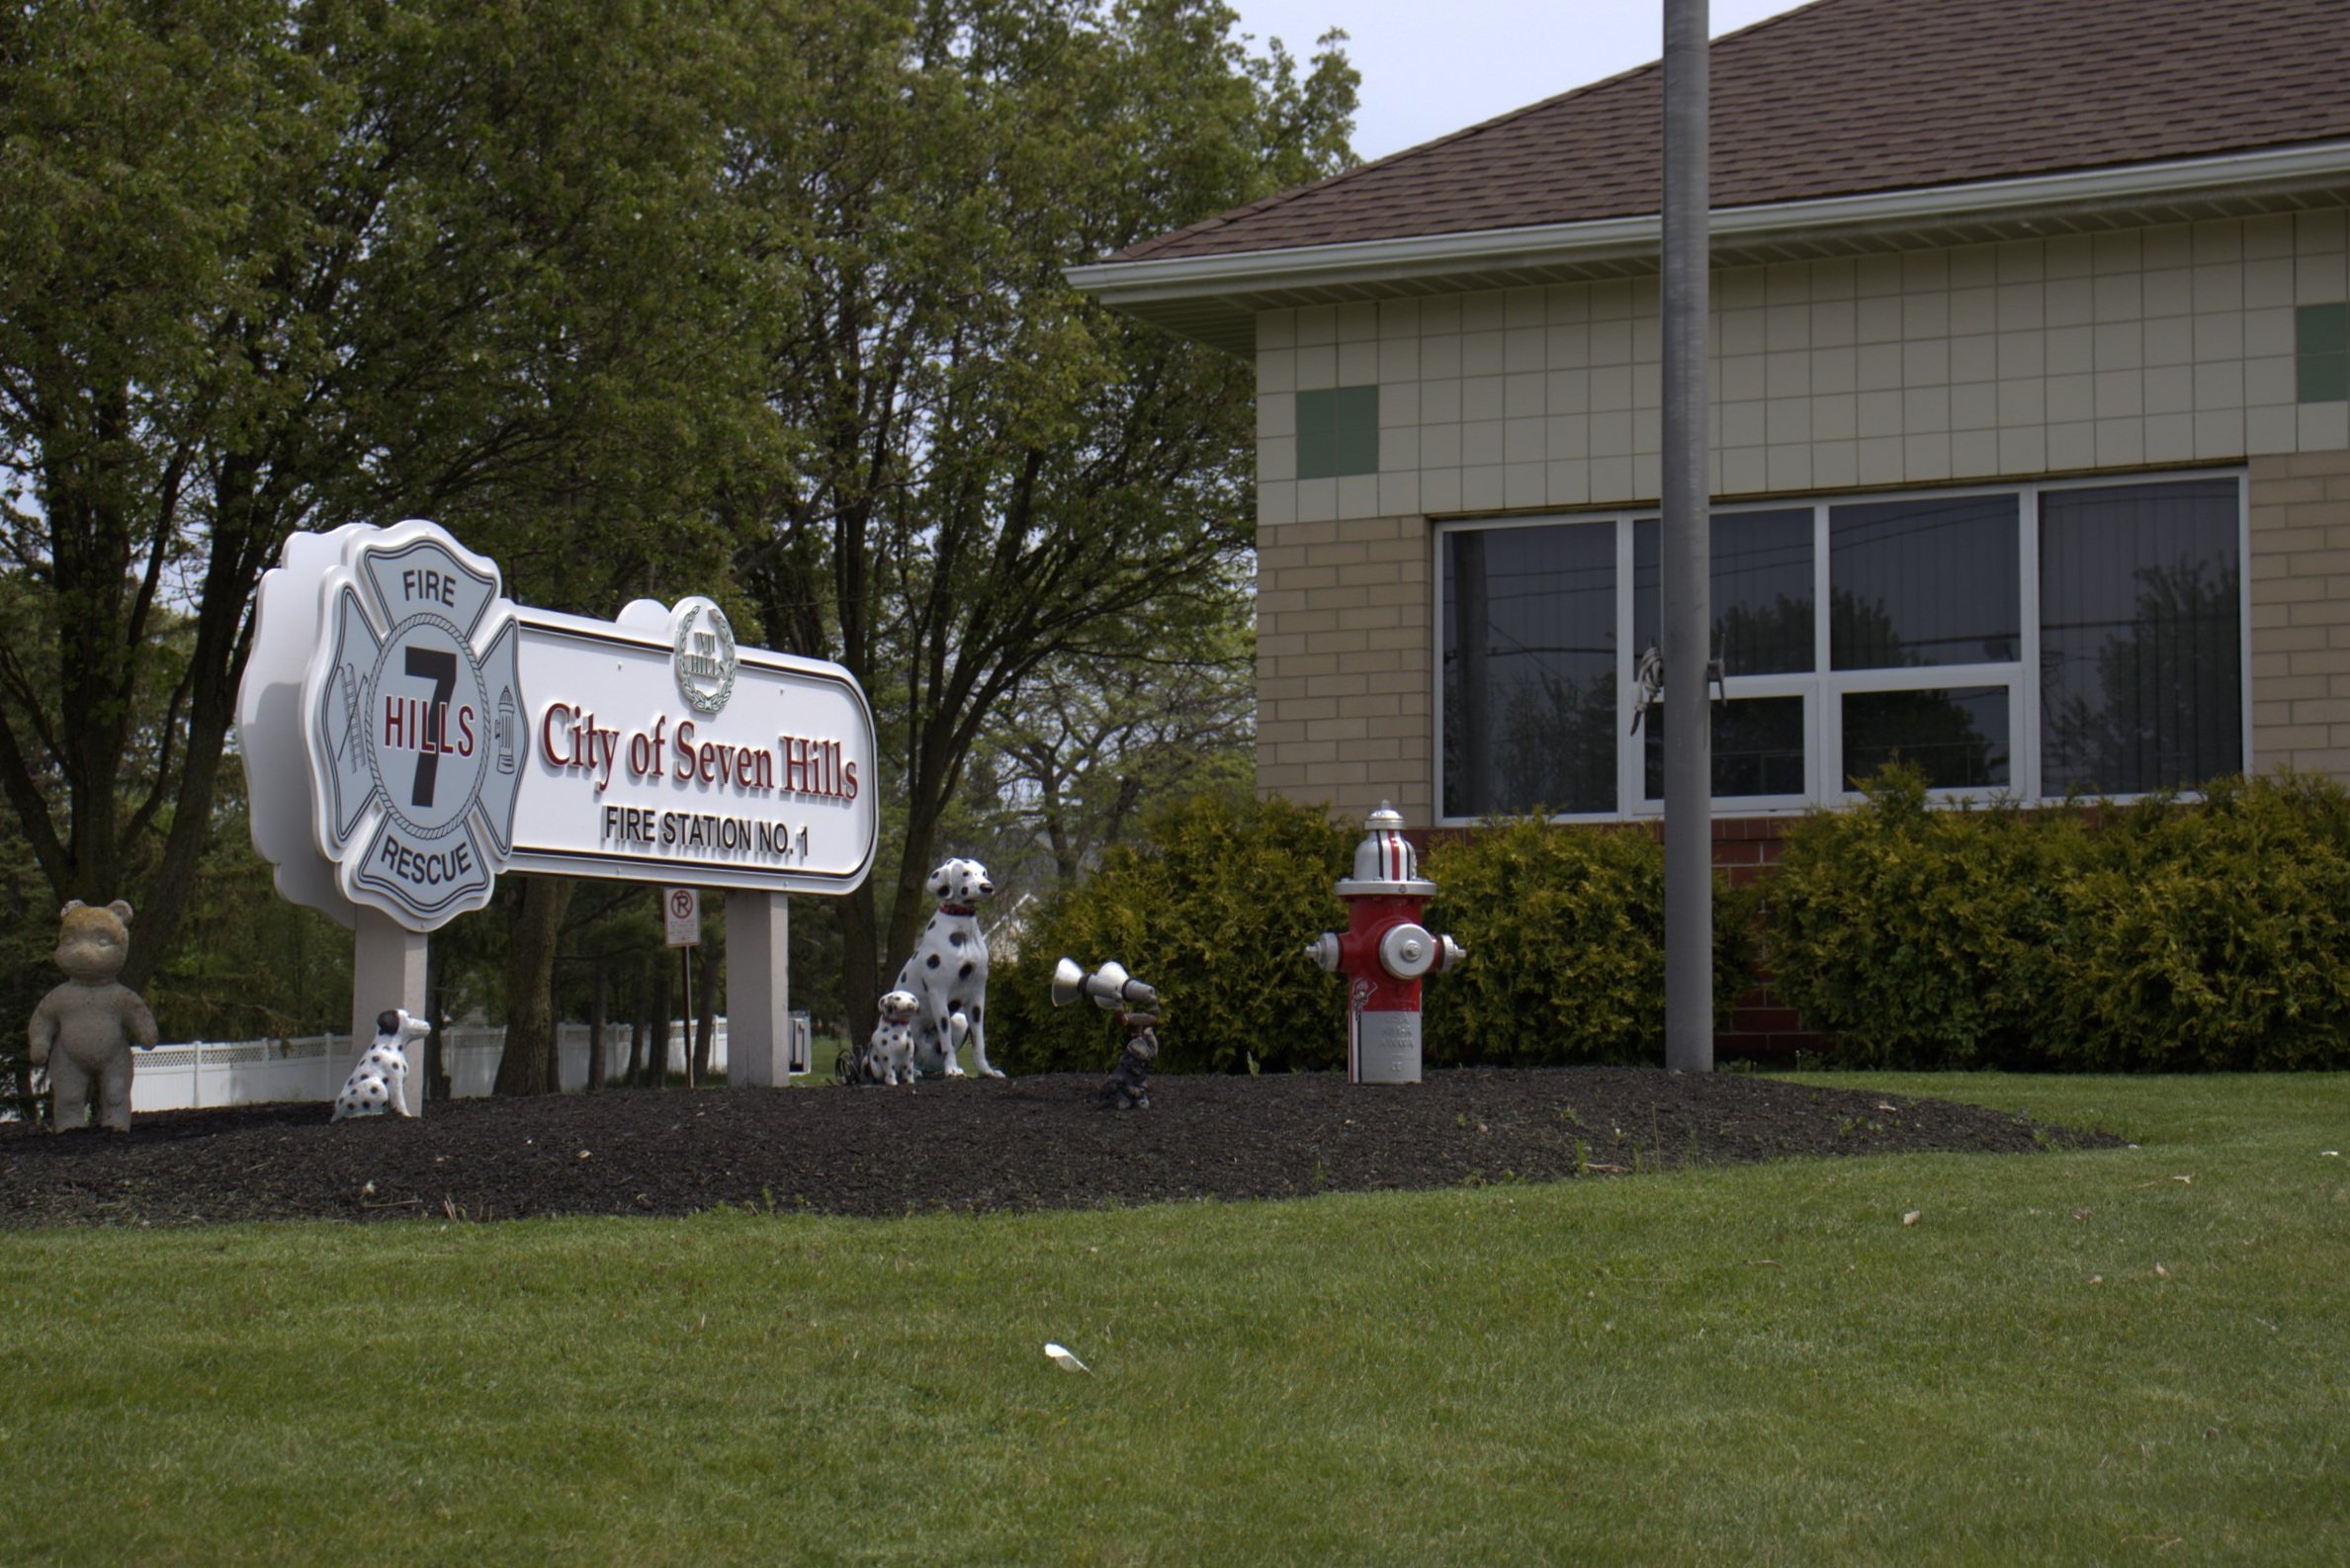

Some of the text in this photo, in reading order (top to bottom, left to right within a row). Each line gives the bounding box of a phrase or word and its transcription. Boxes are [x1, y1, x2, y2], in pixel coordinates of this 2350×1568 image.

[402, 569, 457, 608] FIRE
[689, 654, 726, 677] HILLS
[384, 694, 476, 758] HILLS
[404, 645, 458, 809] 7
[544, 702, 859, 801] City of Seven Hills
[604, 805, 809, 857] FIRE STATION NO. 1
[380, 832, 474, 886] RESCUE
